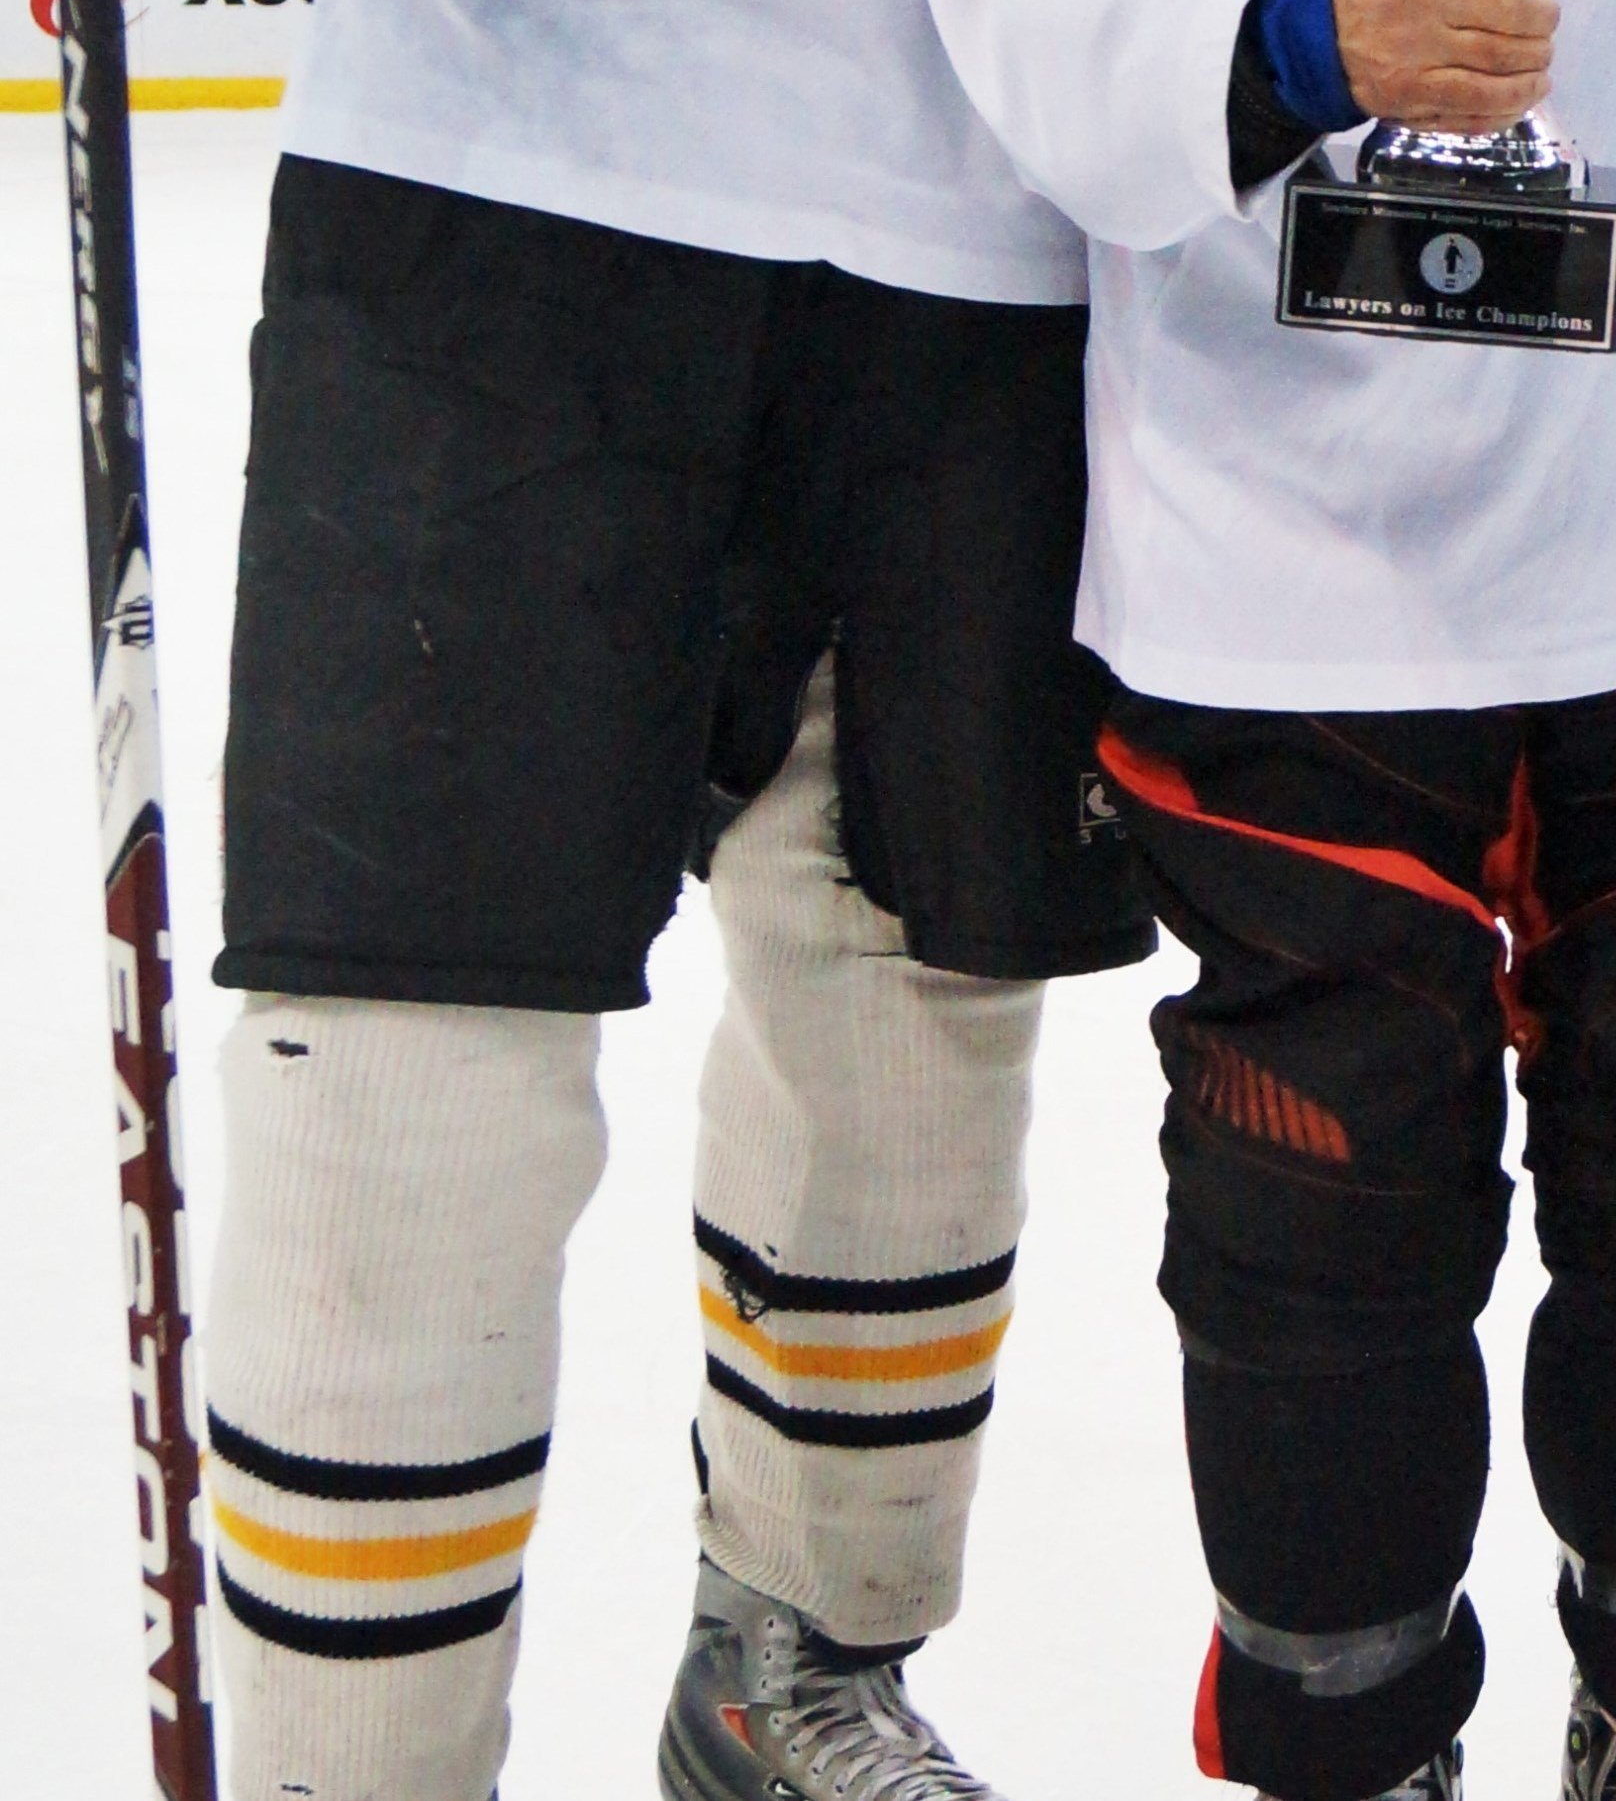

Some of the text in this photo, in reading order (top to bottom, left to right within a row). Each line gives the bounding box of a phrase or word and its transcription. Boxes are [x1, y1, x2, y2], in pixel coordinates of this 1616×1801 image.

[1304, 290, 1594, 333] Lawyers on Ice Champions
